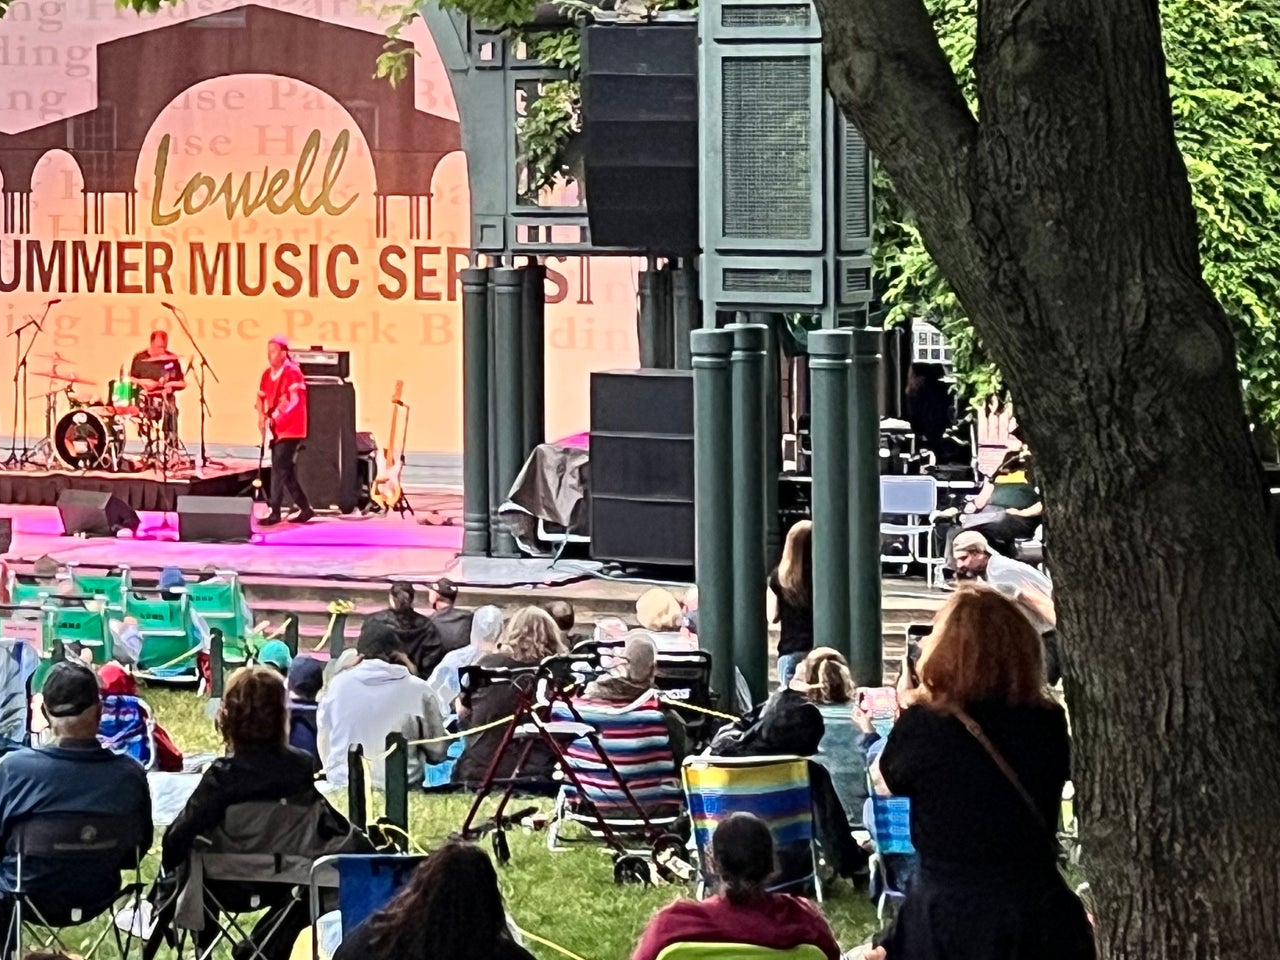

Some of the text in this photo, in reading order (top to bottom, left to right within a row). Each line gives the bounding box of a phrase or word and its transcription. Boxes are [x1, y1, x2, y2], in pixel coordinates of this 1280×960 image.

[151, 128, 360, 227] Lowell
[188, 241, 360, 300] MUSIC
[377, 244, 569, 304] SERS
[100, 304, 262, 341] House
[281, 307, 401, 345] Park
